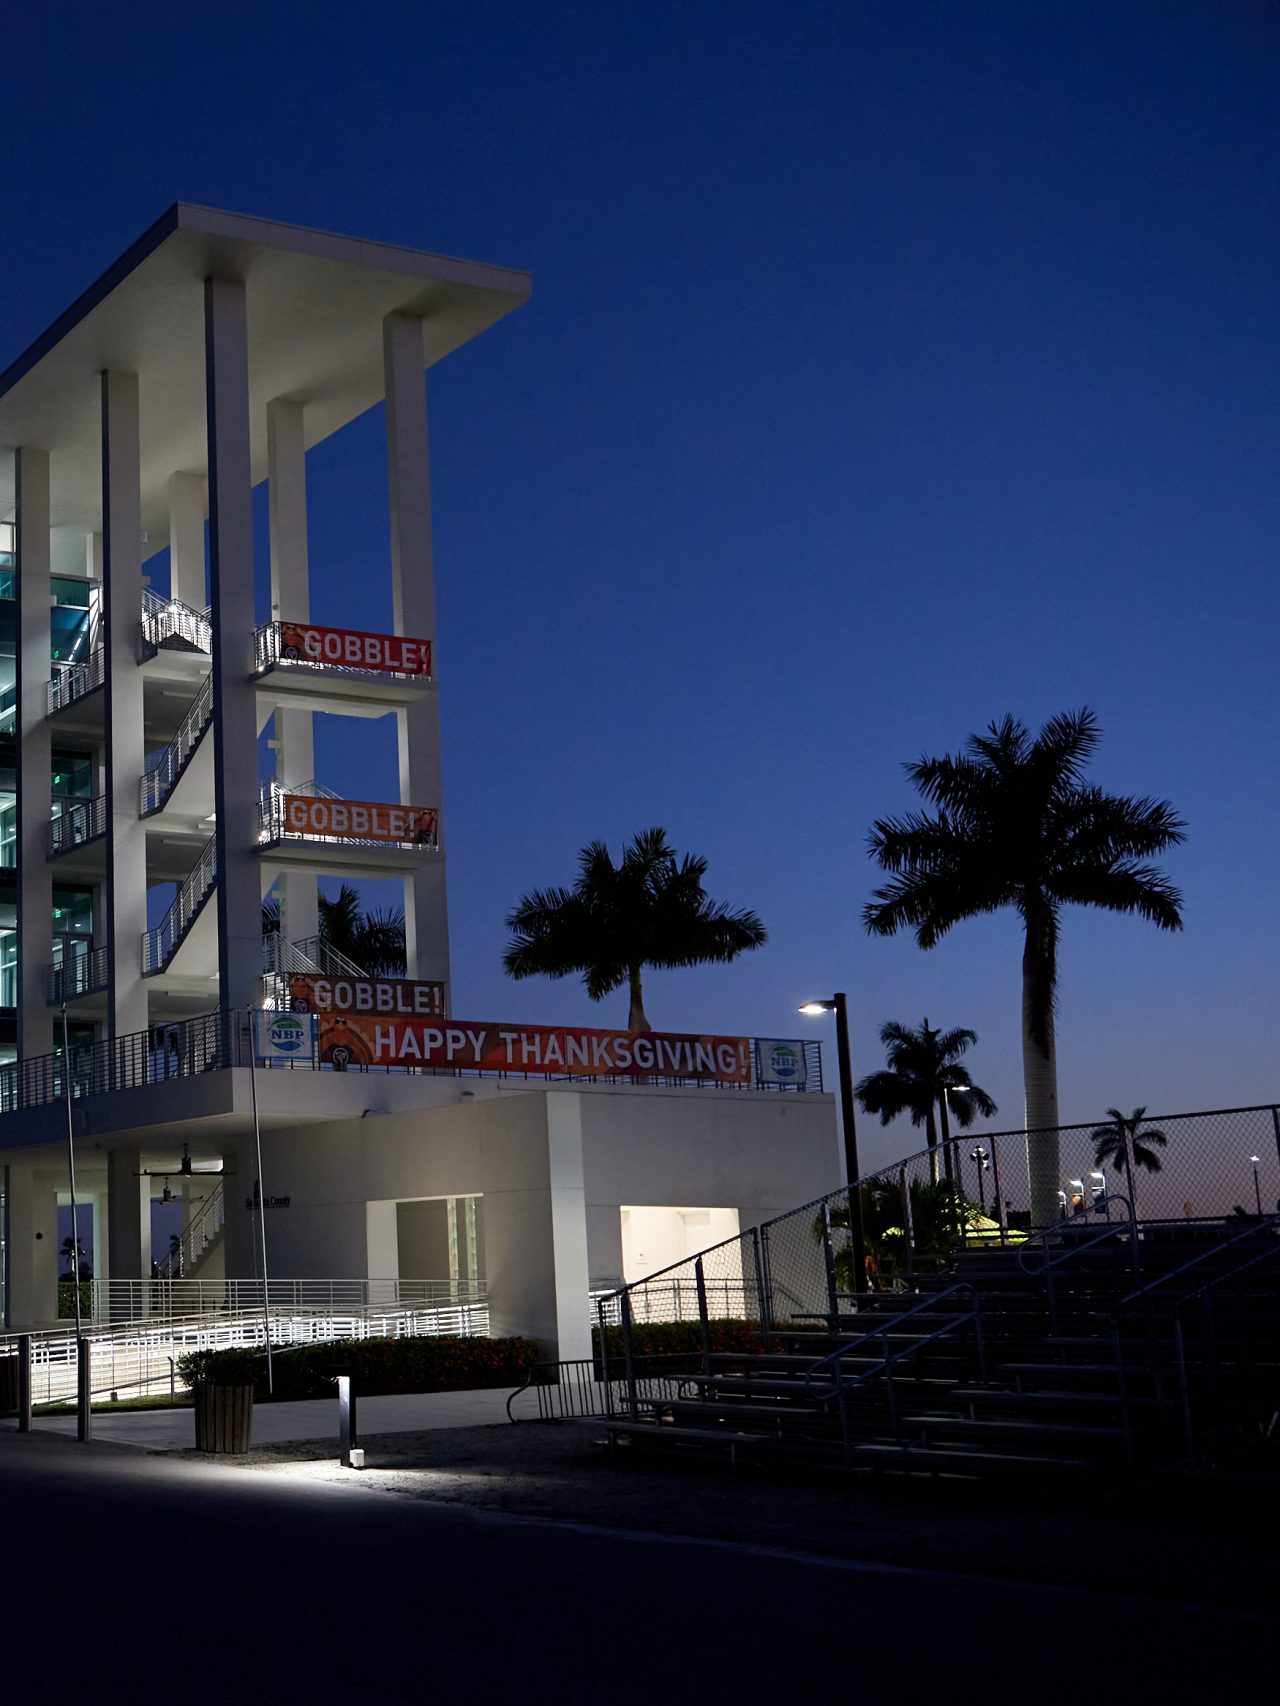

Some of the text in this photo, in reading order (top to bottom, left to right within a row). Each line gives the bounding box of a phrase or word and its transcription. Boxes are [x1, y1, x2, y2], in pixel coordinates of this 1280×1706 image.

[304, 630, 427, 672] GOBBLE!
[290, 800, 415, 838] GOBBLE!
[313, 979, 441, 1014] GOBBLE!
[271, 1030, 305, 1040] NBP
[374, 1025, 747, 1075] HAPPY THANKSGIVING!
[771, 1056, 799, 1067] NBP
